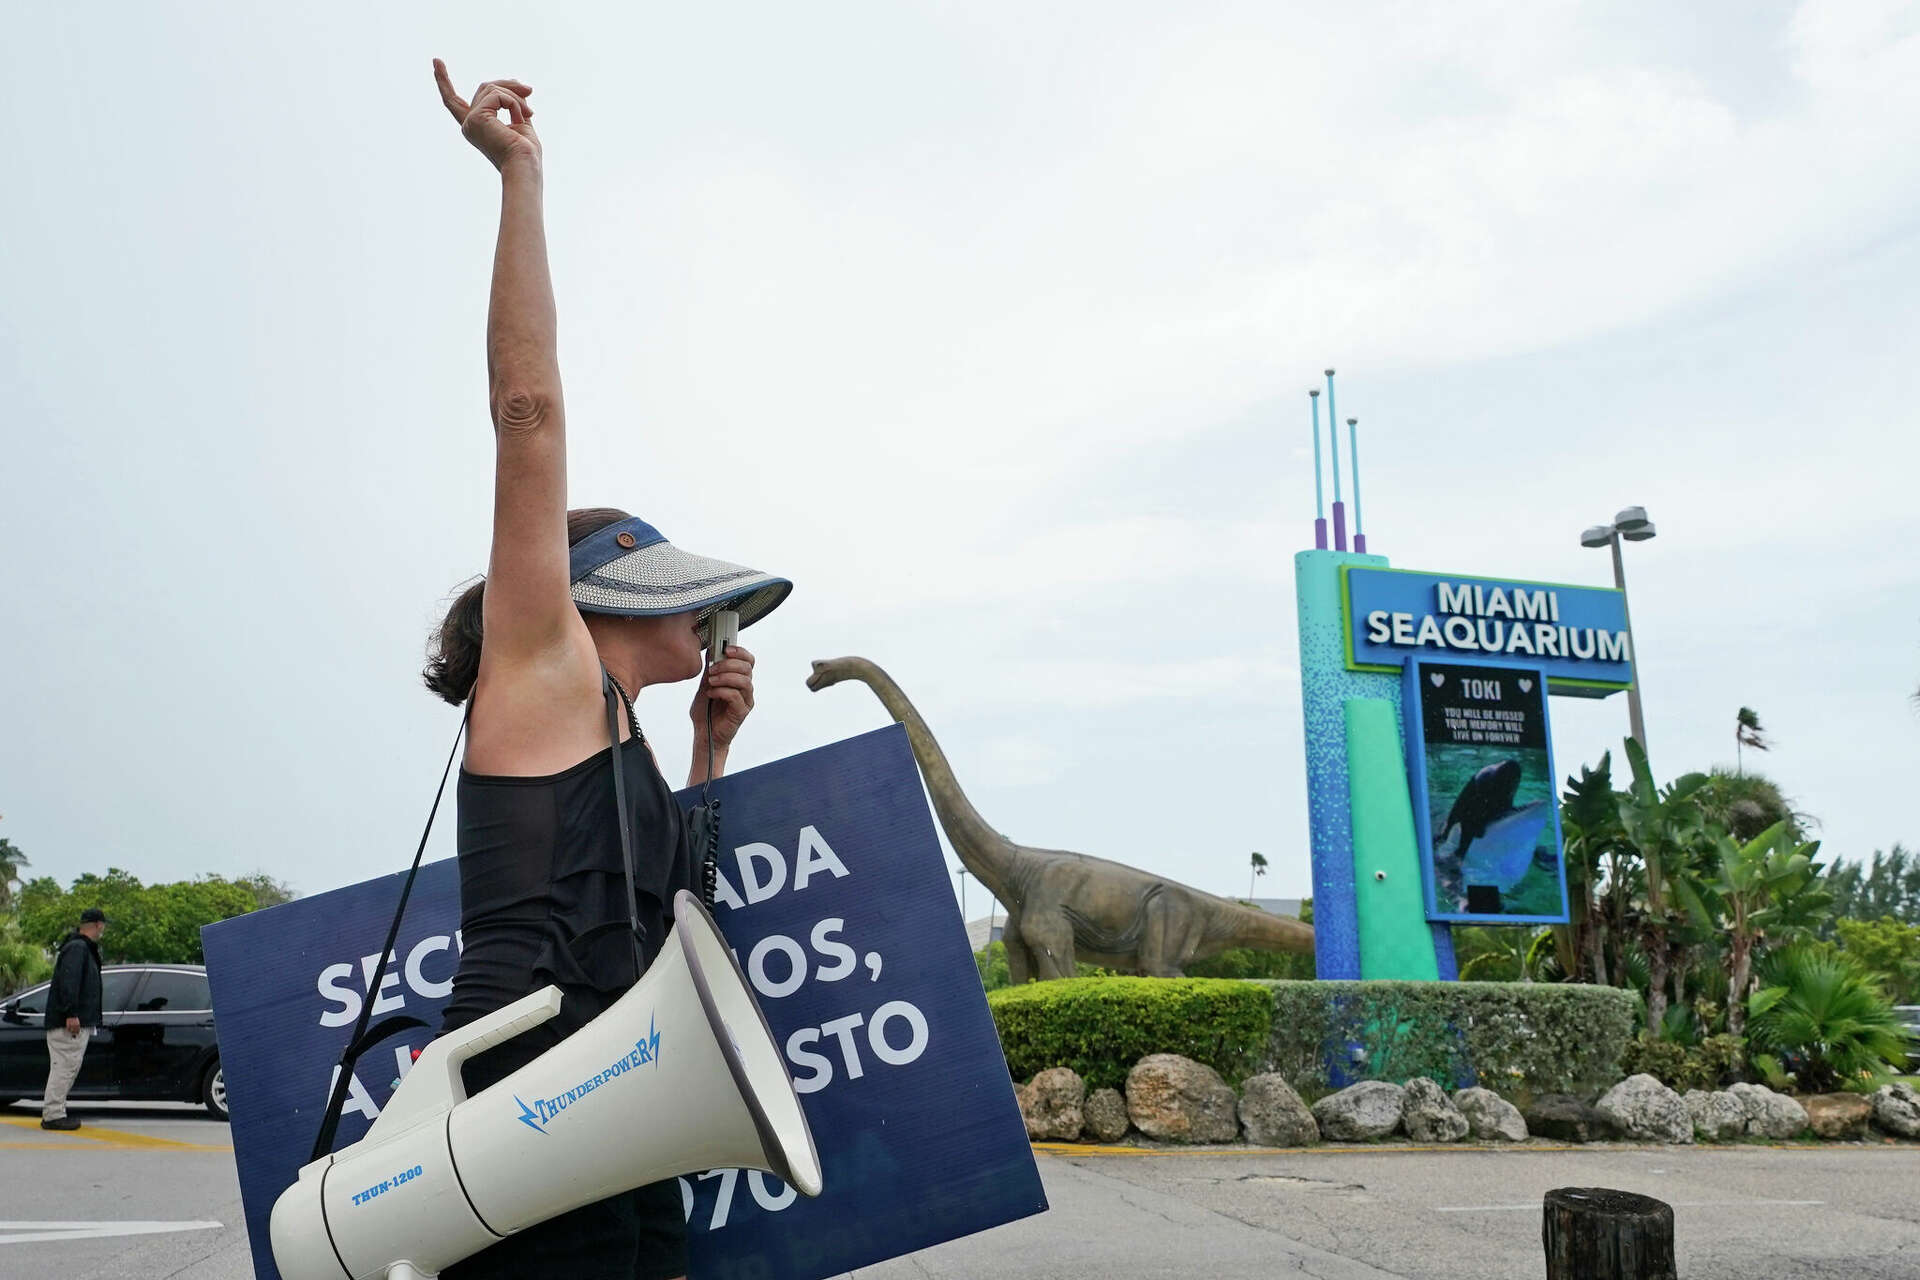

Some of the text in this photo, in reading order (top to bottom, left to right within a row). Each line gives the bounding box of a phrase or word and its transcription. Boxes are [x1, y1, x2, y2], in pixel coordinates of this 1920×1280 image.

[1437, 582, 1559, 622] MIAMI
[1367, 610, 1630, 661] SEAQUARIUM
[1461, 678, 1502, 700] TOKI
[1444, 707, 1525, 722] YOU WILL BE MISSED
[1445, 718, 1524, 732] YOUR MEMORY WILL
[1452, 730, 1470, 740] LIVE
[1484, 731, 1520, 743] FOREVER
[317, 929, 463, 1028] SEC
[731, 917, 883, 999] OS,
[534, 1037, 653, 1126] THUNDERPOWER
[351, 1165, 423, 1206] THUN-1200
[677, 1167, 798, 1231] 70
